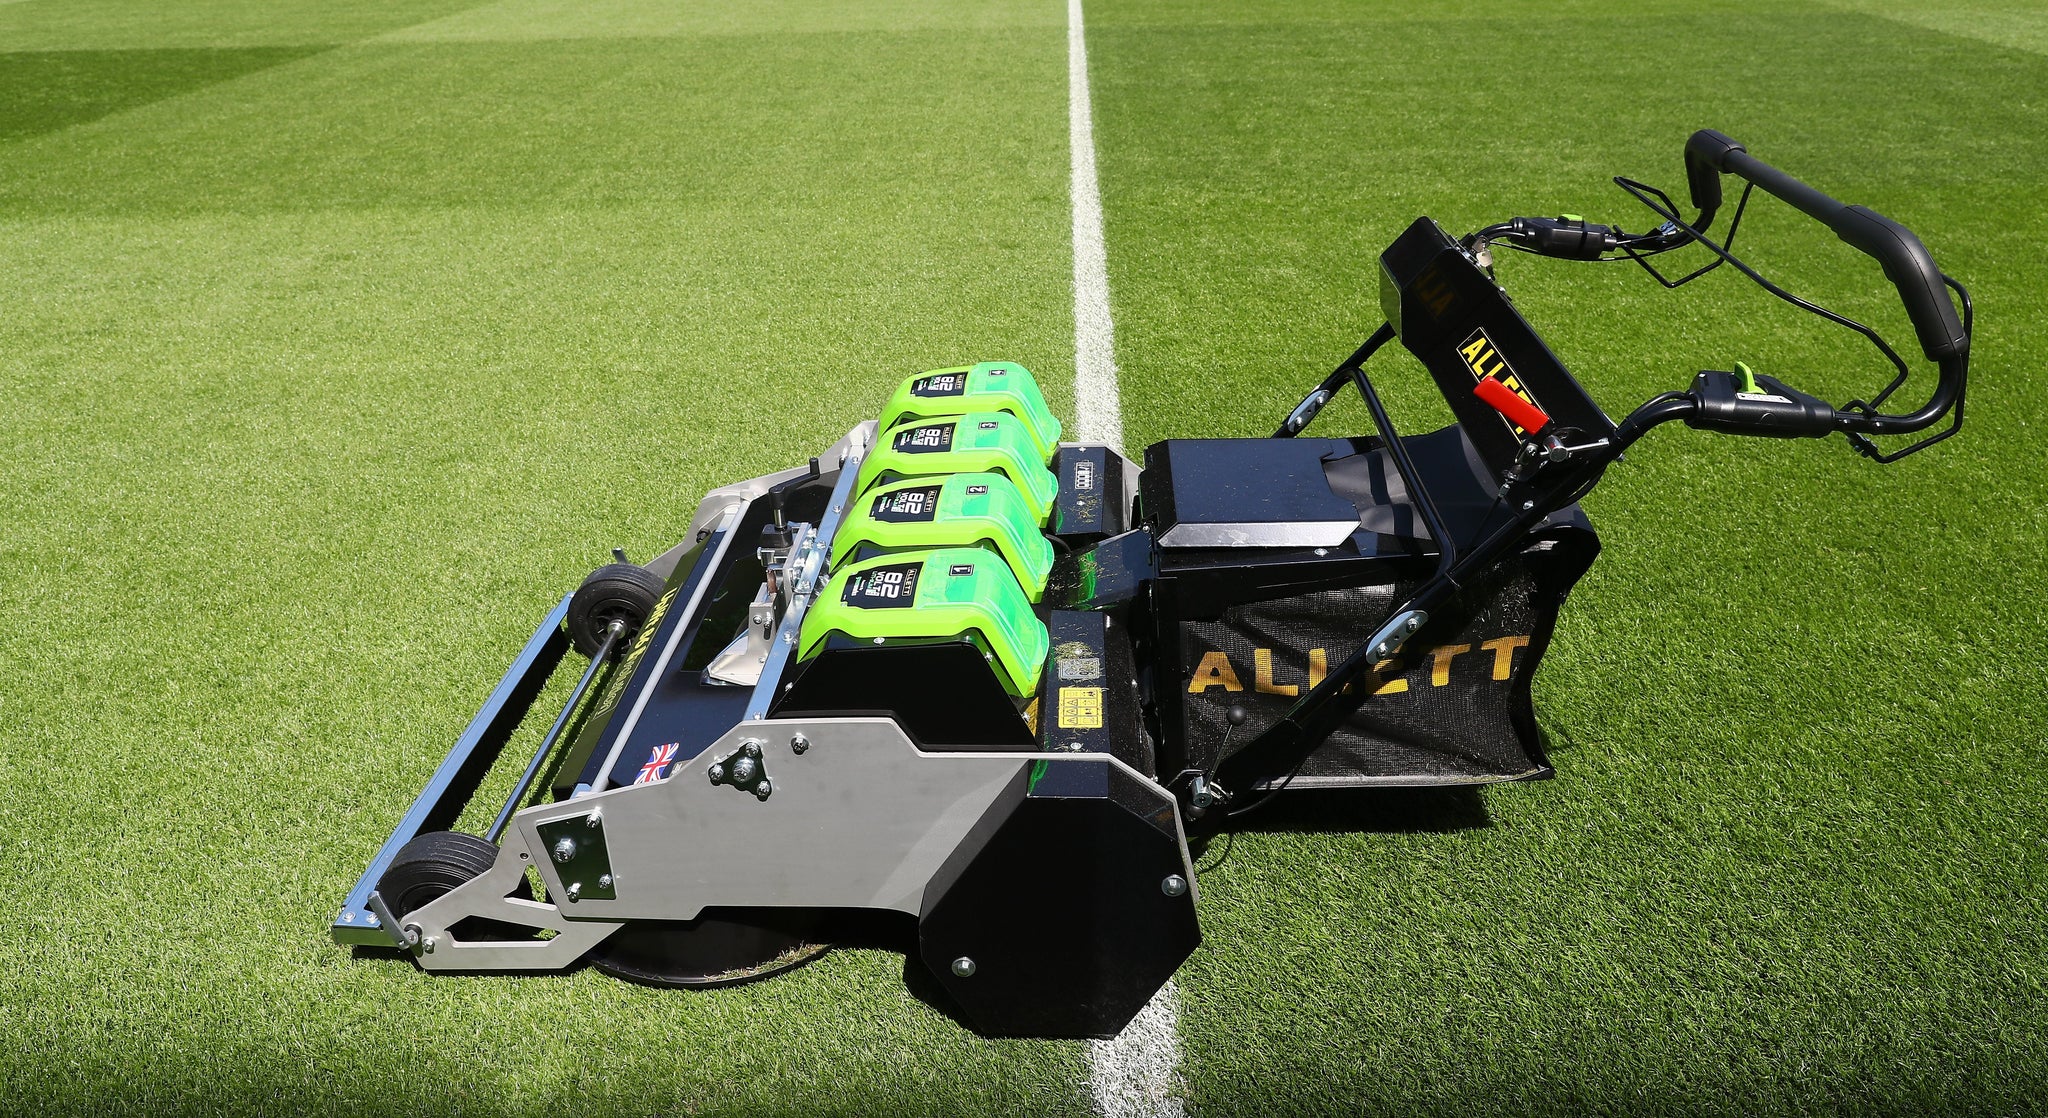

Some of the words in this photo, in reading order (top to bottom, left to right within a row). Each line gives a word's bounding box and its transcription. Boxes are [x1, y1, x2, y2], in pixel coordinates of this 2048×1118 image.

[940, 376, 955, 391] 82
[924, 429, 941, 446] 82
[898, 492, 910, 509] VOLT
[904, 493, 925, 514] 82
[924, 490, 937, 512] ALLETT
[873, 571, 886, 592] VOLT
[880, 572, 903, 598] 82
[903, 569, 917, 595] ALLETT
